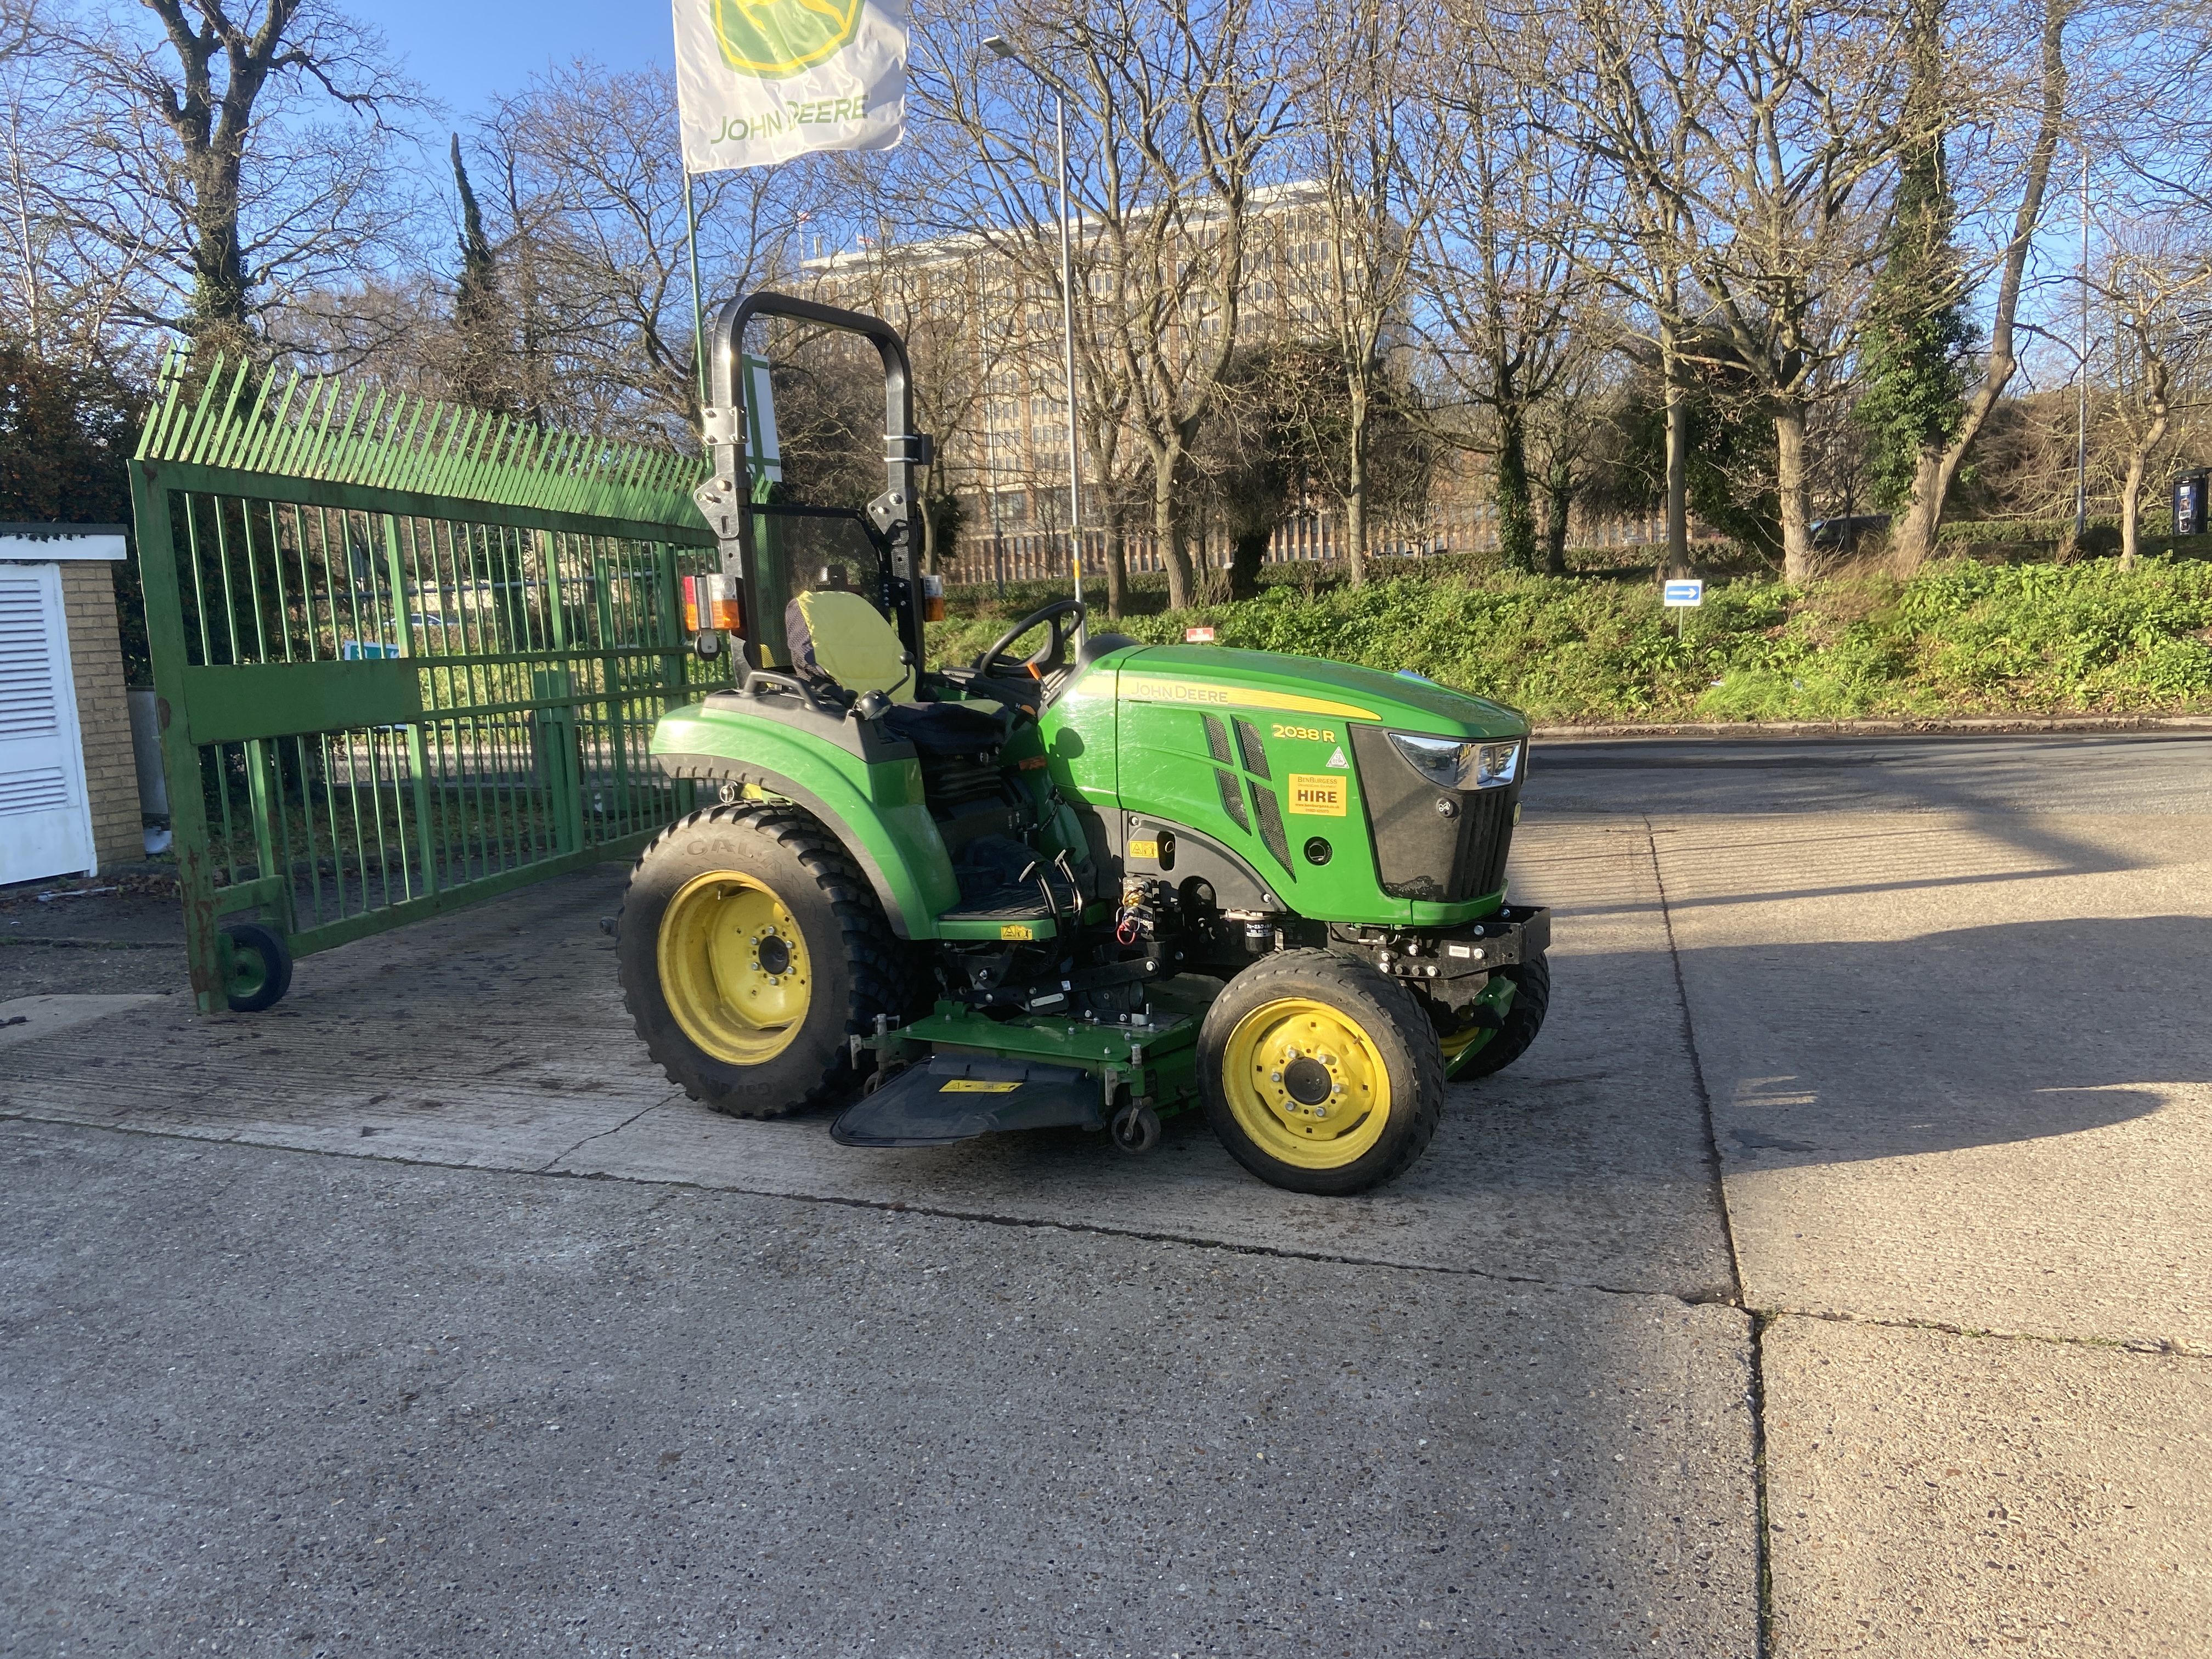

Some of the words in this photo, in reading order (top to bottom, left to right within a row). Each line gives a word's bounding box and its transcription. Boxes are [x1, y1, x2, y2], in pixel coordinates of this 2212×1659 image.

[710, 110, 783, 144] JOHN
[785, 95, 868, 131] DEERE
[1131, 682, 1172, 698] JOHN
[1176, 685, 1228, 703] DEERE
[1272, 724, 1320, 741] 2038
[1322, 729, 1336, 743] R
[1297, 789, 1337, 803] HIRE
